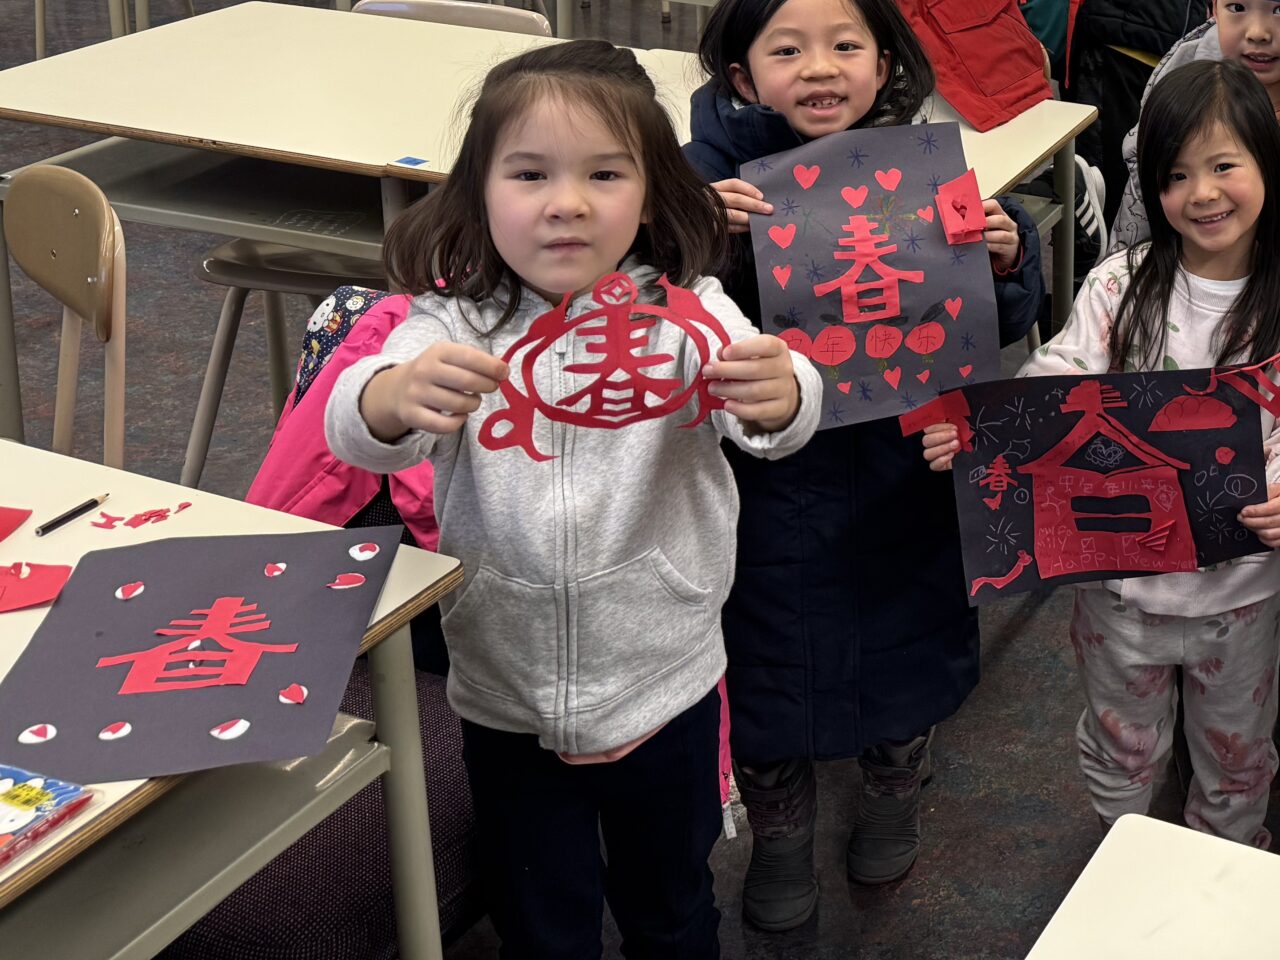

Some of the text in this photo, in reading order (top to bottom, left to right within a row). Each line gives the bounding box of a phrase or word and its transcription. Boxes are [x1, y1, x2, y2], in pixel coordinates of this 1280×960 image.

[813, 215, 925, 324] 春
[979, 454, 1019, 491] 春
[95, 596, 299, 695] 春
